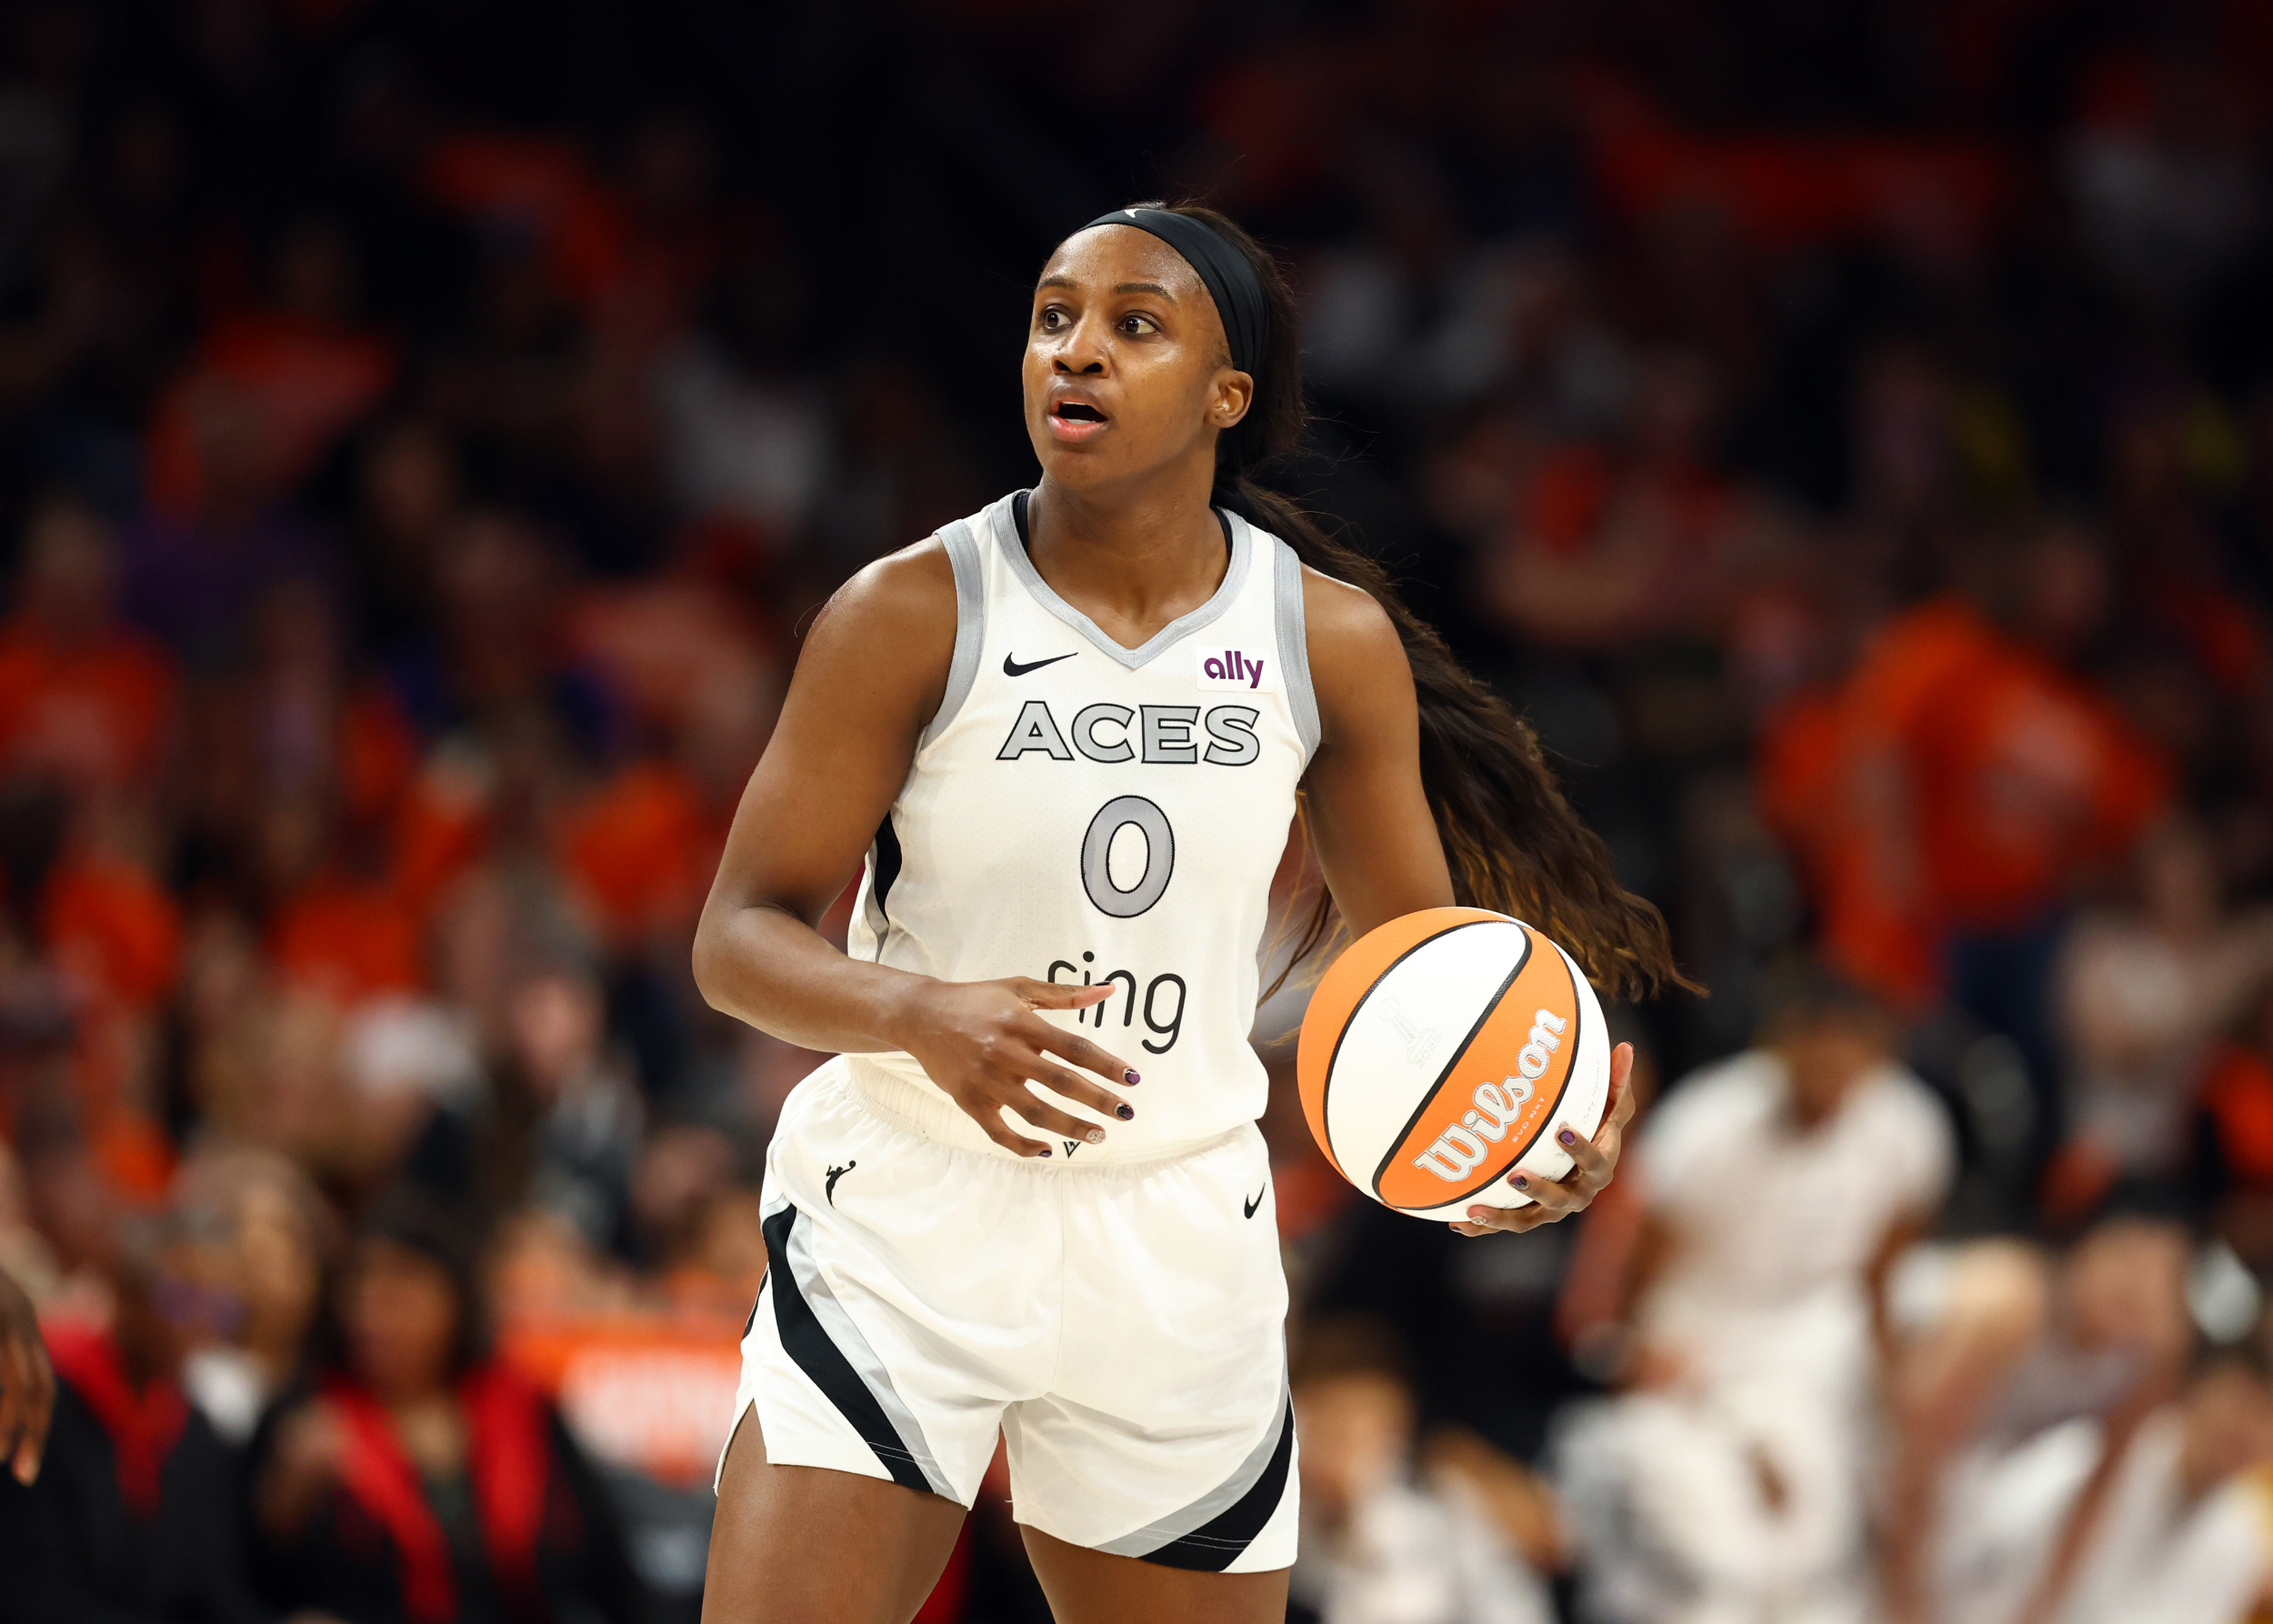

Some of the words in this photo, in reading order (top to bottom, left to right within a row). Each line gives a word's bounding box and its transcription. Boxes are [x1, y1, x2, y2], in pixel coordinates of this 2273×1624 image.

[1203, 650, 1265, 689] ally
[996, 700, 1260, 767] ACES
[1080, 795, 1176, 918] 0
[1412, 1008, 1567, 1182] Wilson
[1512, 1120, 1529, 1143] EVO
[1529, 1097, 1546, 1118] NXT
